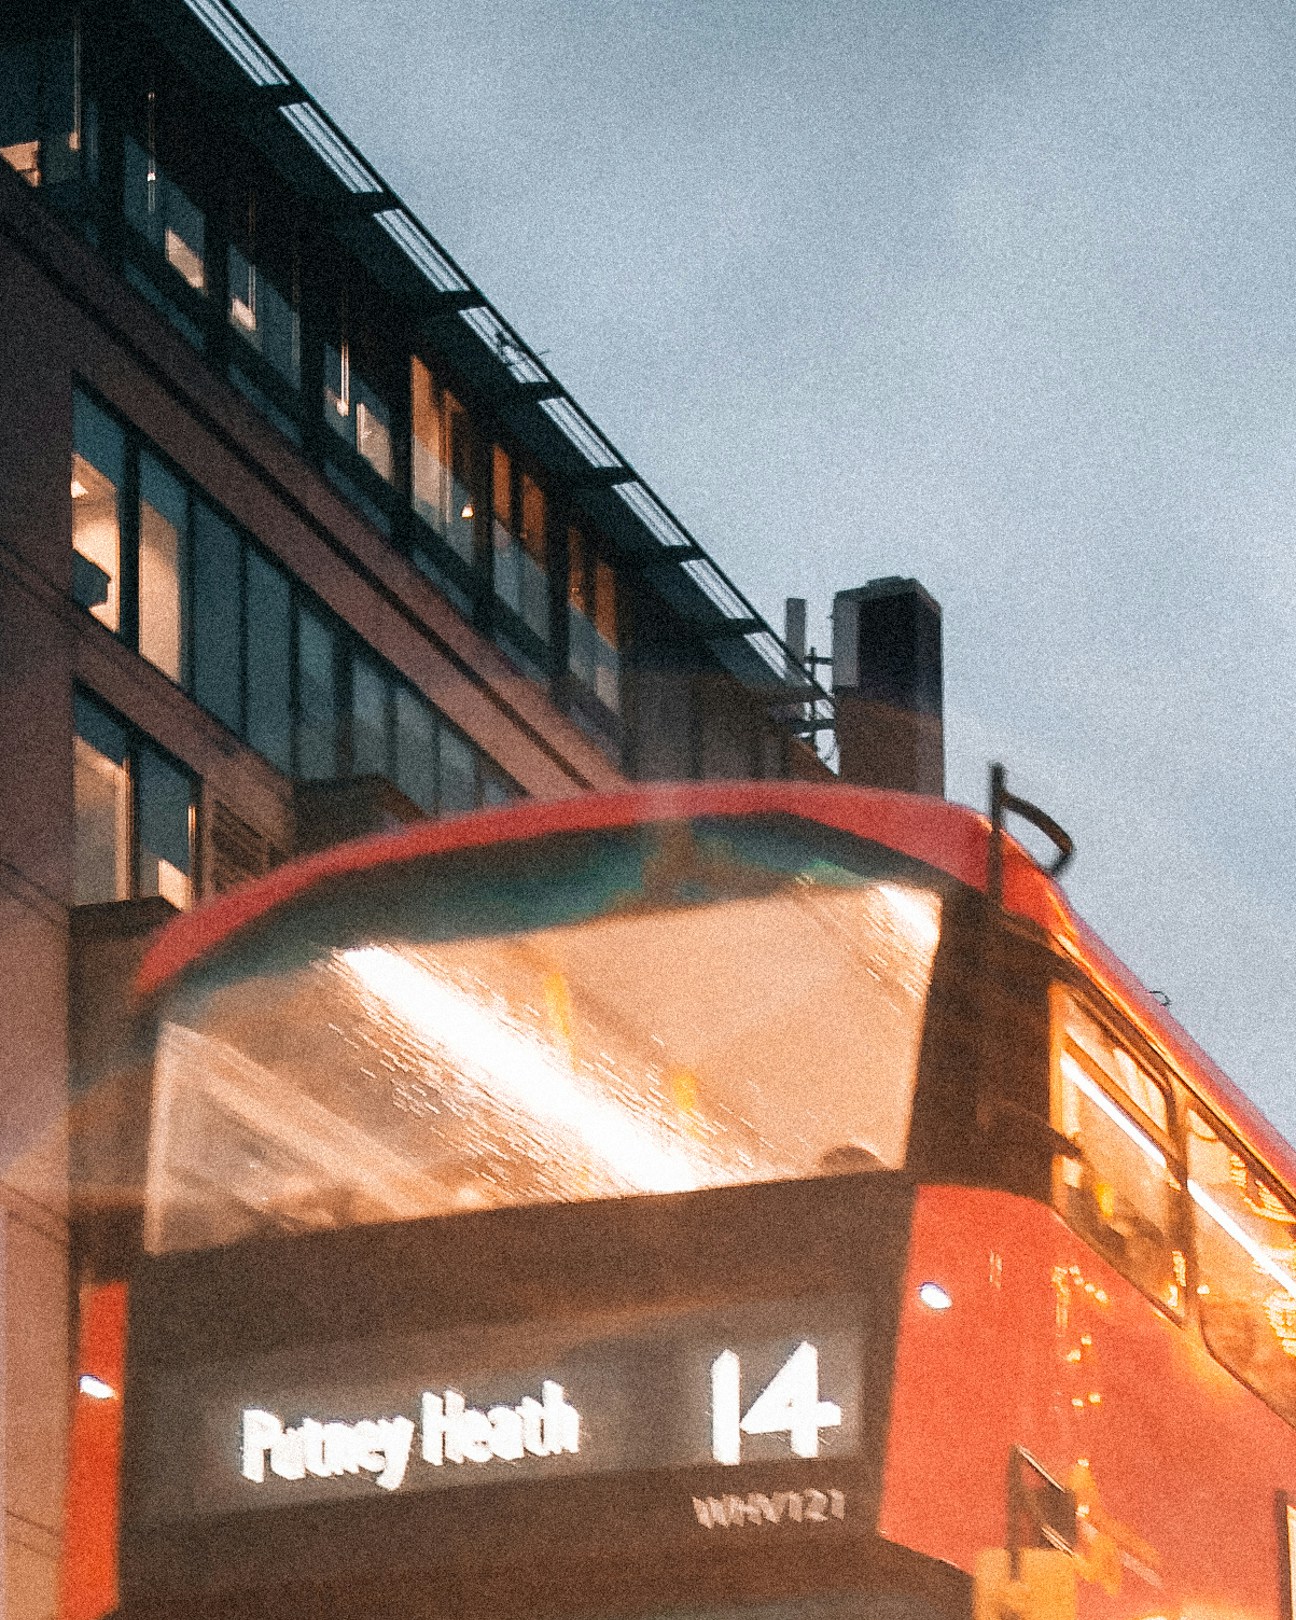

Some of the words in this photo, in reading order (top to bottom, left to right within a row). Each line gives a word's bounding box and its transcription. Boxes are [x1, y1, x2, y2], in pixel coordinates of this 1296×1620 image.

[241, 1407, 415, 1491] Putney
[421, 1380, 580, 1466] Heath
[710, 1341, 842, 1465] 14
